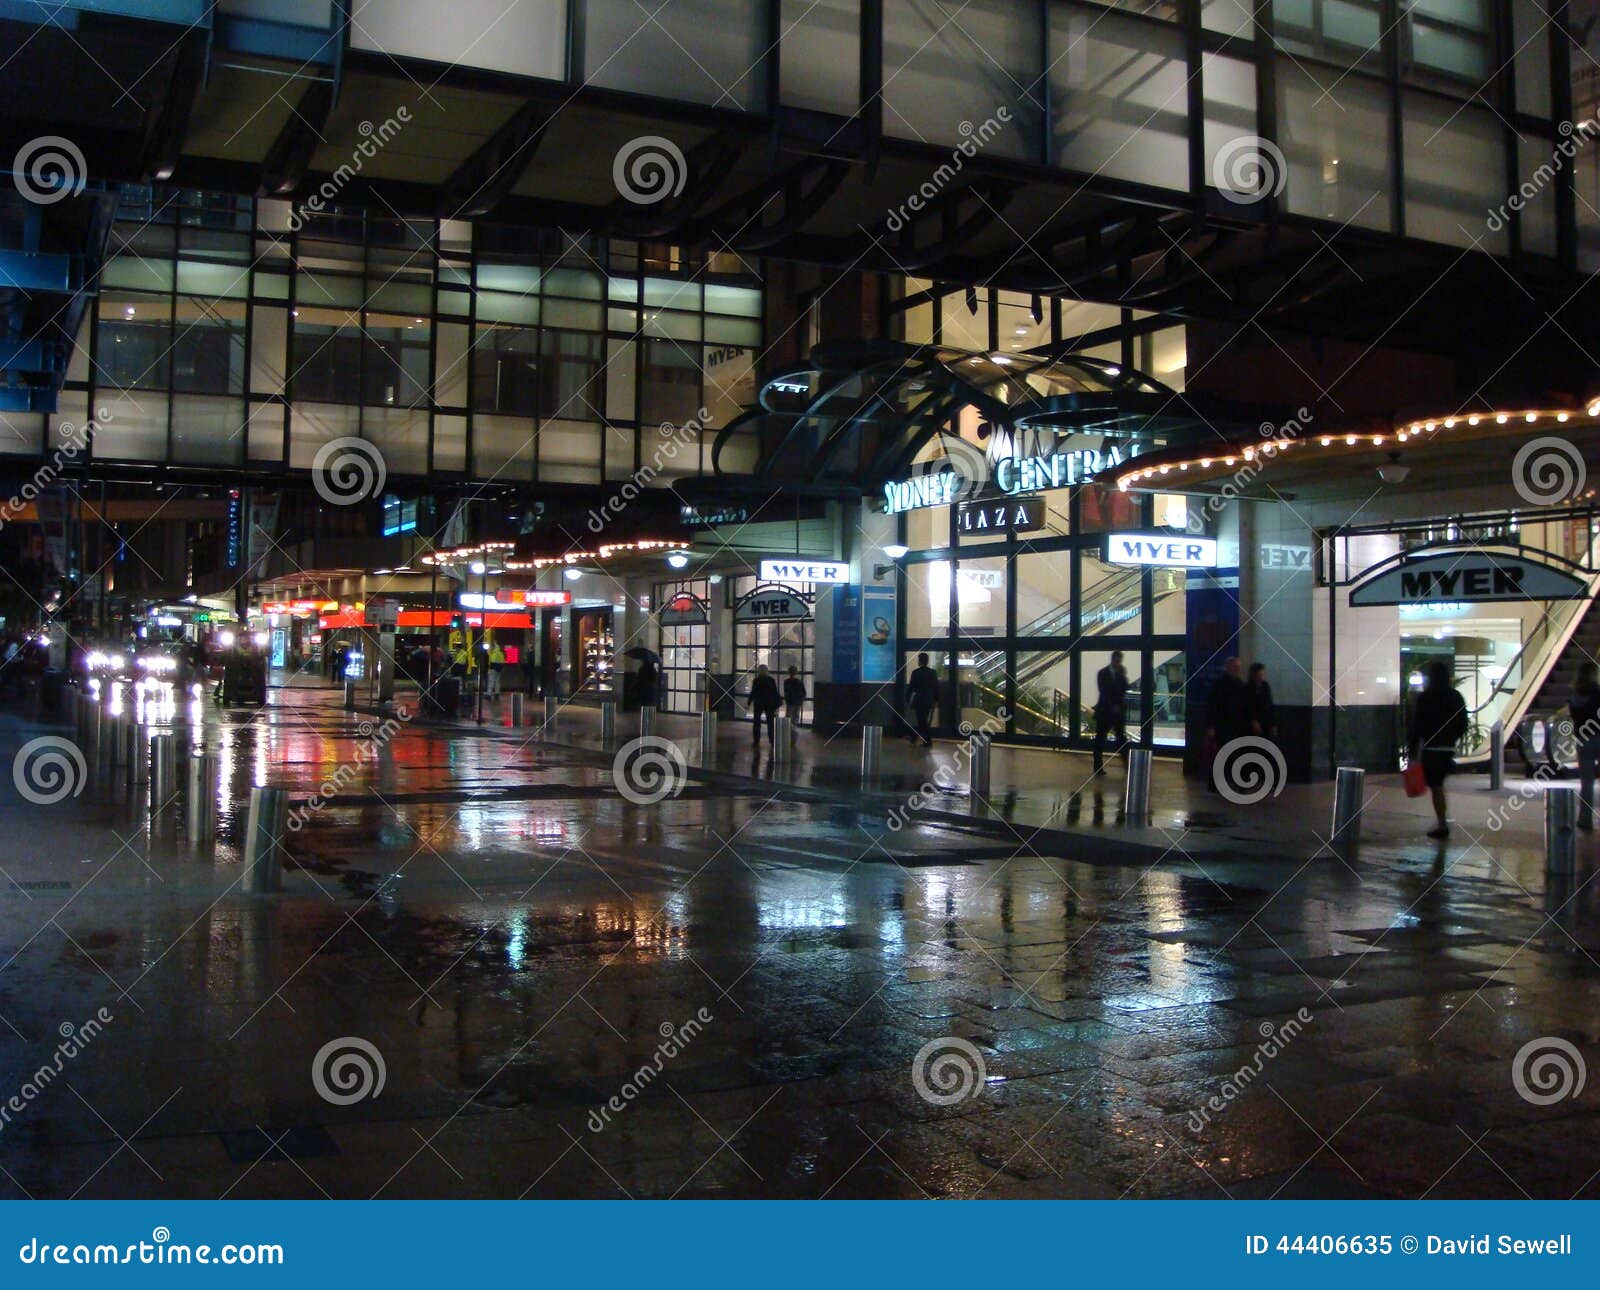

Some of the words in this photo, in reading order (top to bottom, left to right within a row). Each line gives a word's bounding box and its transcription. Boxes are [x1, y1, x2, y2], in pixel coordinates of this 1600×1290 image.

[882, 471, 955, 516] SYDNEY
[957, 505, 1030, 531] LAZA
[1122, 541, 1203, 561] MYER
[772, 565, 838, 579] MYER
[1401, 566, 1525, 598] MYER
[750, 599, 790, 615] MYER
